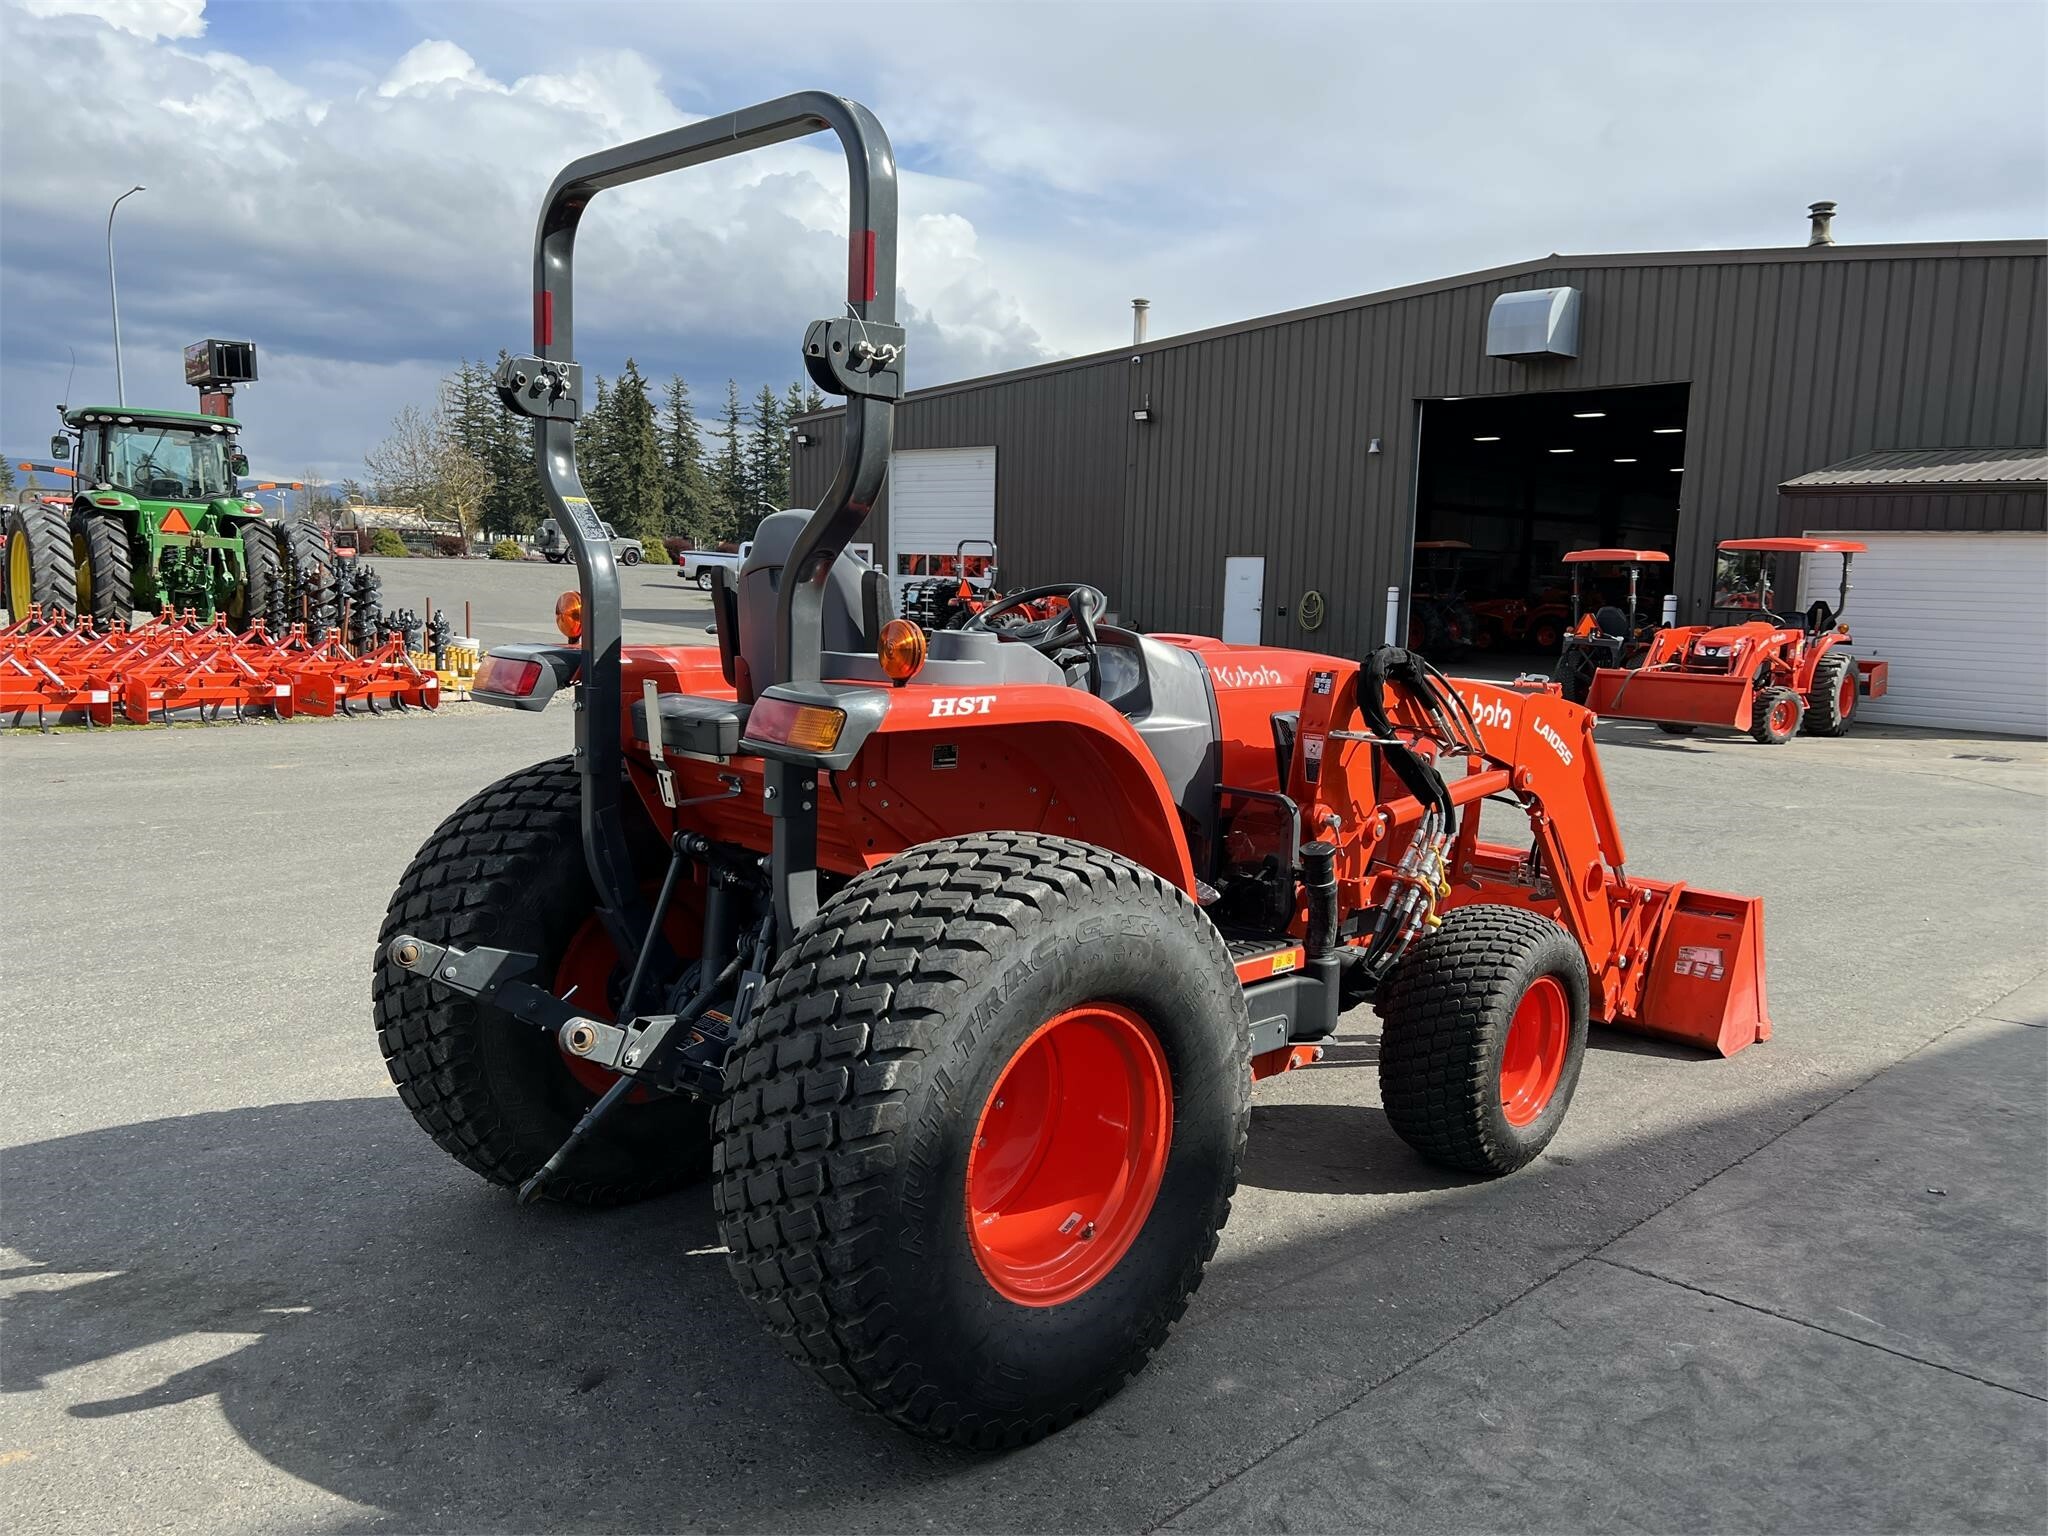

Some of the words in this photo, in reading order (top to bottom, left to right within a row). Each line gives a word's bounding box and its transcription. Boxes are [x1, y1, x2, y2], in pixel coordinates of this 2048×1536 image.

[1213, 665, 1282, 688] Kubota
[928, 695, 997, 718] HST
[1447, 690, 1512, 730] Kbota
[1533, 716, 1574, 766] LA1055
[898, 1064, 956, 1256] MULTI
[952, 934, 1057, 1059] TRAC
